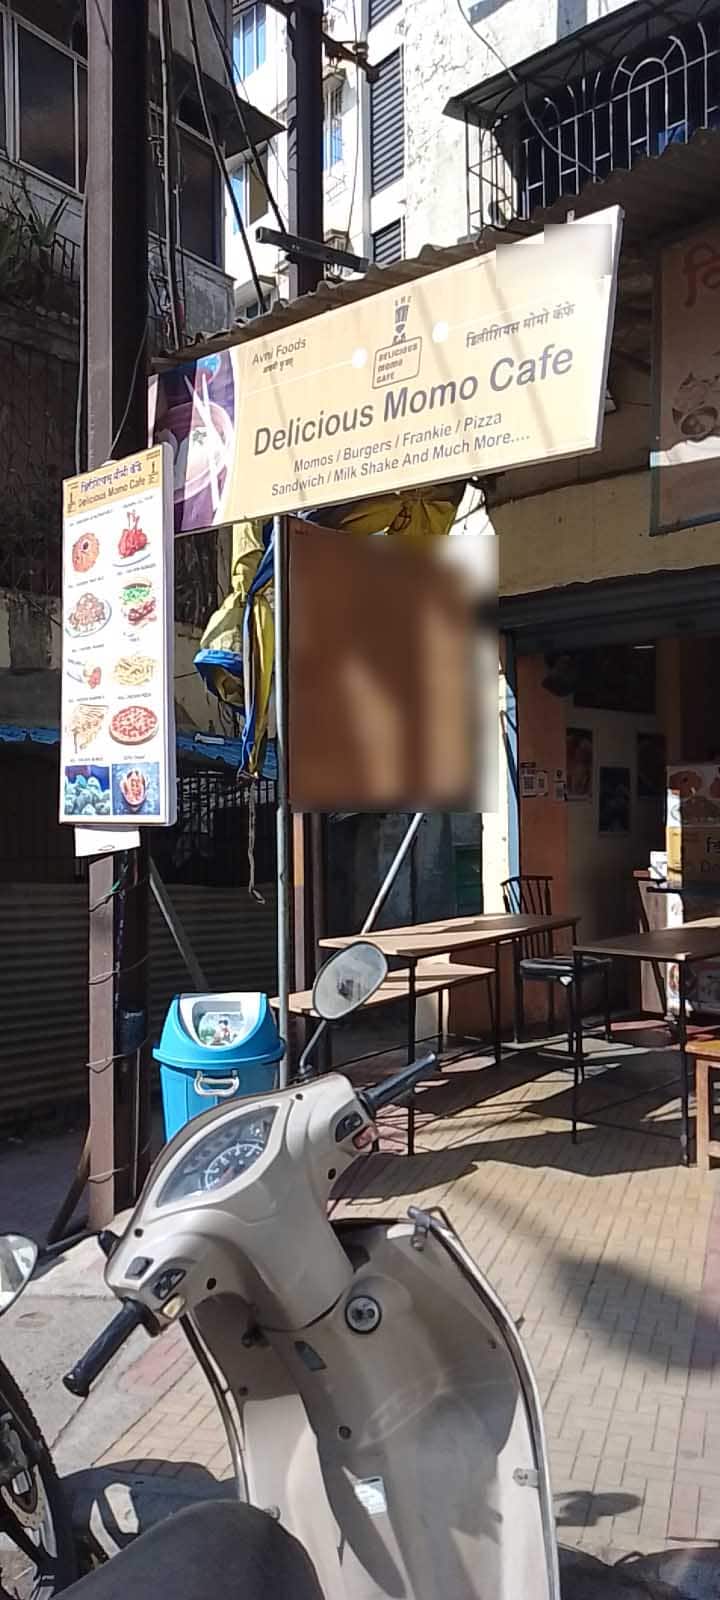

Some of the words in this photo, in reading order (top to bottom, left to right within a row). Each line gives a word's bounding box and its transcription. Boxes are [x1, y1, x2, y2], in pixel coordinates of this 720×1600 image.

[523, 307, 550, 329] मोमो
[252, 346, 274, 366] Avni
[276, 337, 307, 358] Foods
[254, 404, 374, 456] Delicious
[383, 375, 478, 423] Momo
[489, 343, 573, 392] Cafe
[294, 453, 334, 473] Momos
[343, 440, 392, 461] Burgers
[402, 423, 451, 447] Frankie
[463, 412, 502, 432] Pizza
[108, 484, 128, 497] Momo
[129, 476, 146, 490] Cafe
[271, 473, 325, 496] Sandwich
[333, 465, 357, 483] Milk
[360, 457, 399, 477] Shake
[402, 449, 429, 467] And
[432, 441, 470, 460] Much
